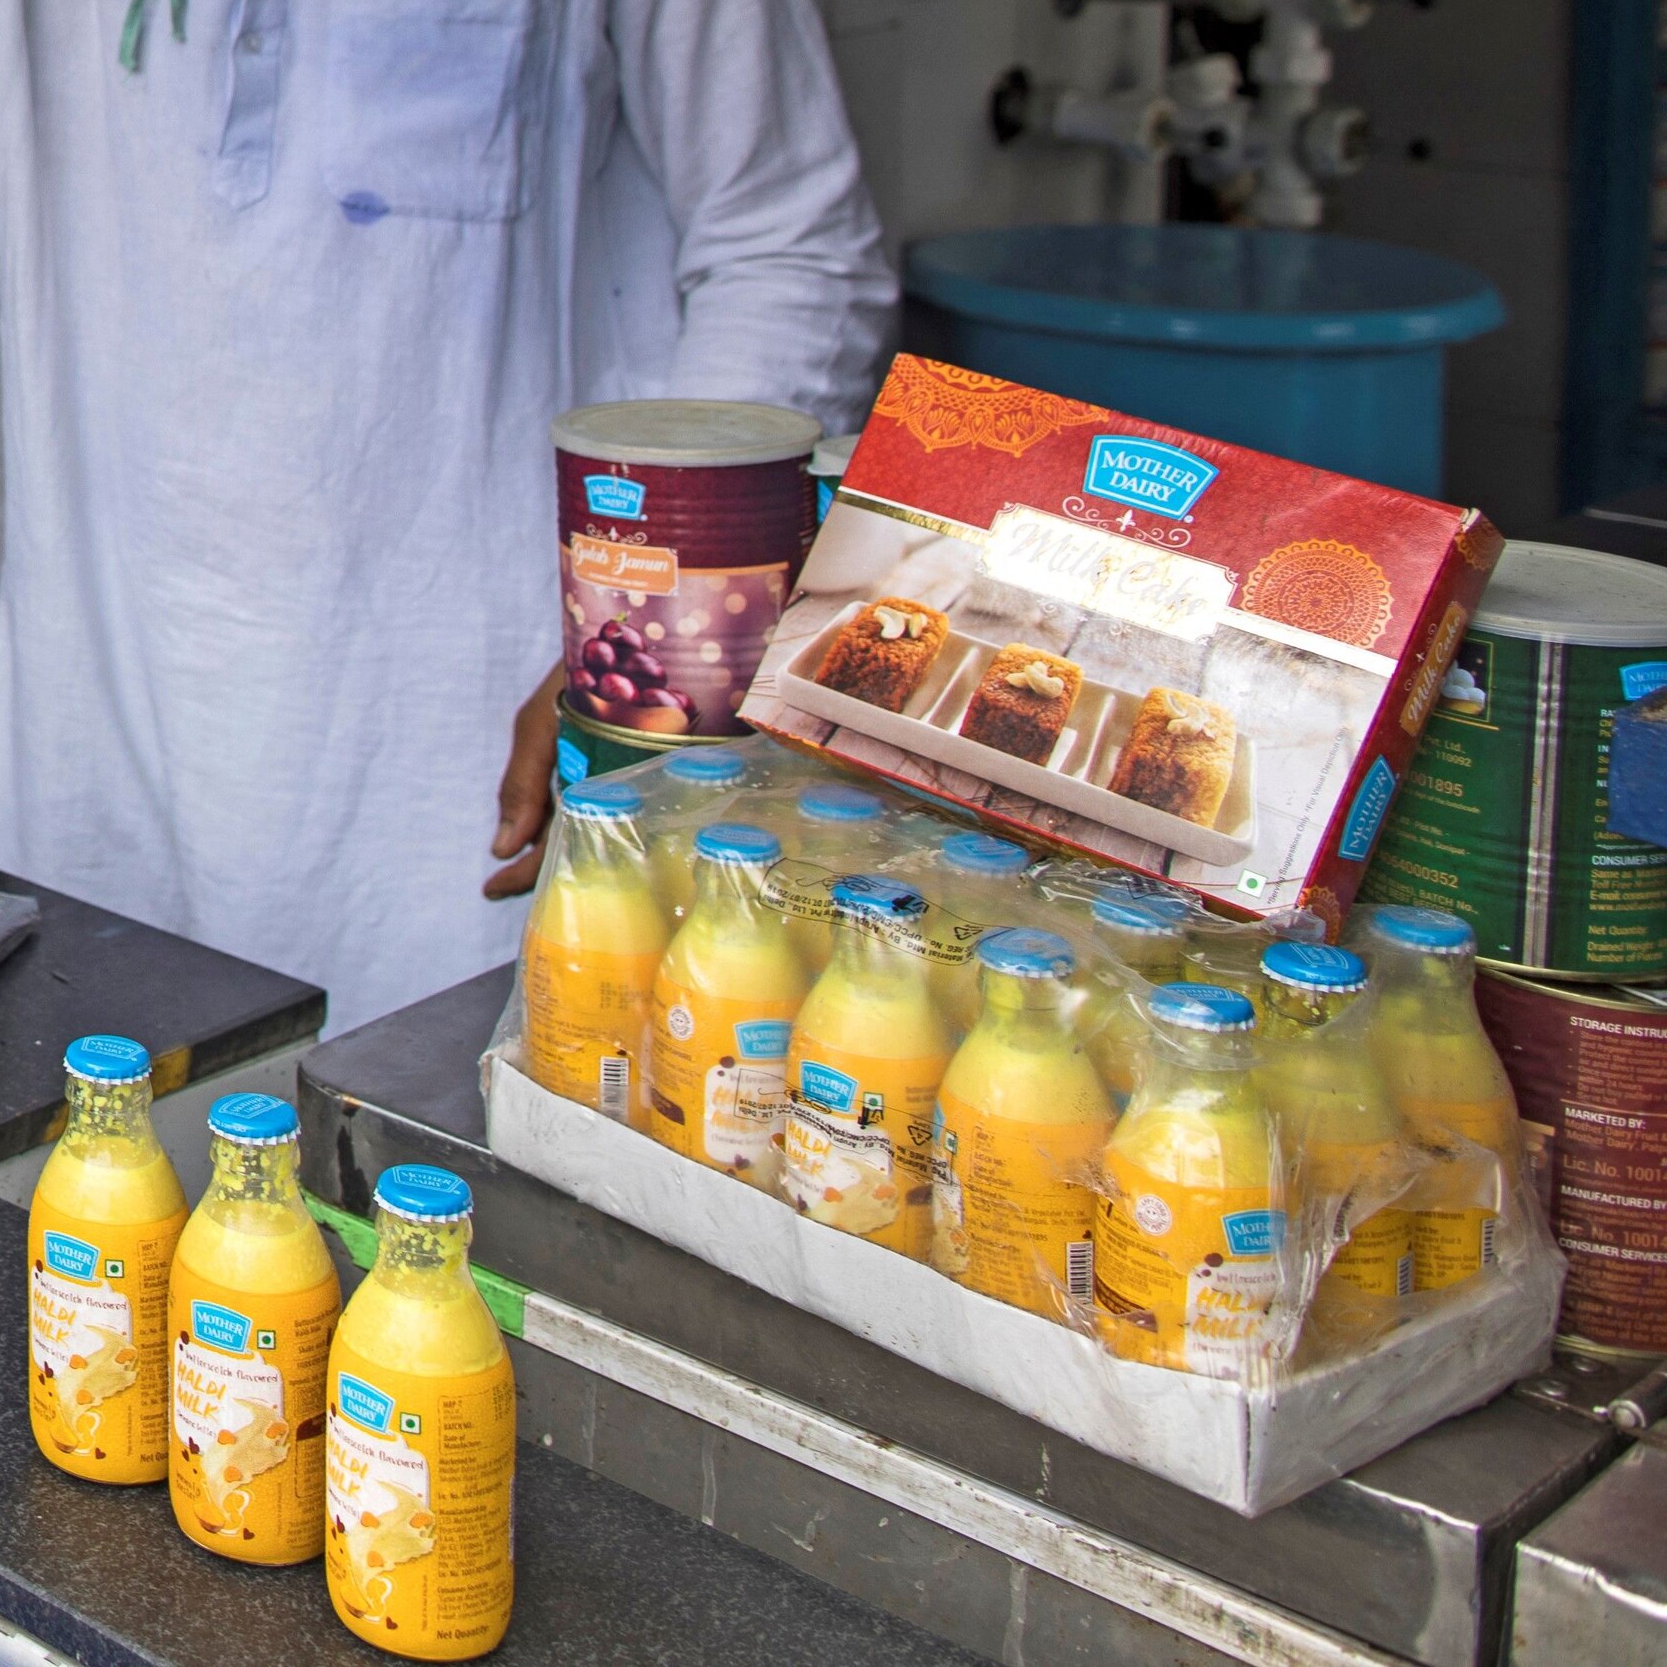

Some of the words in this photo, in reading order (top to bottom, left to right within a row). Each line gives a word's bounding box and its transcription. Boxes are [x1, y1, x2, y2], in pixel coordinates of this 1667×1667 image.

[1101, 450, 1198, 493] MOTHER
[1109, 471, 1177, 503] DAIRY
[613, 550, 669, 575] Jamun
[1009, 523, 1106, 586] Milk
[1117, 560, 1207, 616] Cake
[1407, 670, 1437, 724] Milk
[1350, 771, 1388, 849] MOTHER
[1591, 855, 1647, 866] CONSUMER
[1570, 1016, 1622, 1034] STORAGE
[1624, 1025, 1667, 1040] INSTRU
[803, 1070, 849, 1095] MOTHER
[1565, 1107, 1626, 1127] MARKETED
[1628, 1118, 1646, 1129] BY:
[1626, 1166, 1667, 1181] 1001
[1561, 1185, 1652, 1209] MANUFACTURED
[48, 1241, 93, 1265] MOTHER
[1559, 1237, 1619, 1257] CONSUMER
[54, 1254, 84, 1273] DAIRY
[33, 1287, 77, 1326] HALDI
[32, 1310, 70, 1344] MILK
[196, 1310, 243, 1335] MOTHER
[203, 1324, 235, 1344] DAIRY
[176, 1358, 227, 1402] HALDI
[176, 1385, 220, 1421] MILK
[342, 1384, 386, 1416] MOTHER
[347, 1398, 378, 1423] DAIRY
[327, 1436, 368, 1480] HALDI
[327, 1462, 362, 1498] MILK
[436, 1629, 452, 1640] Net
